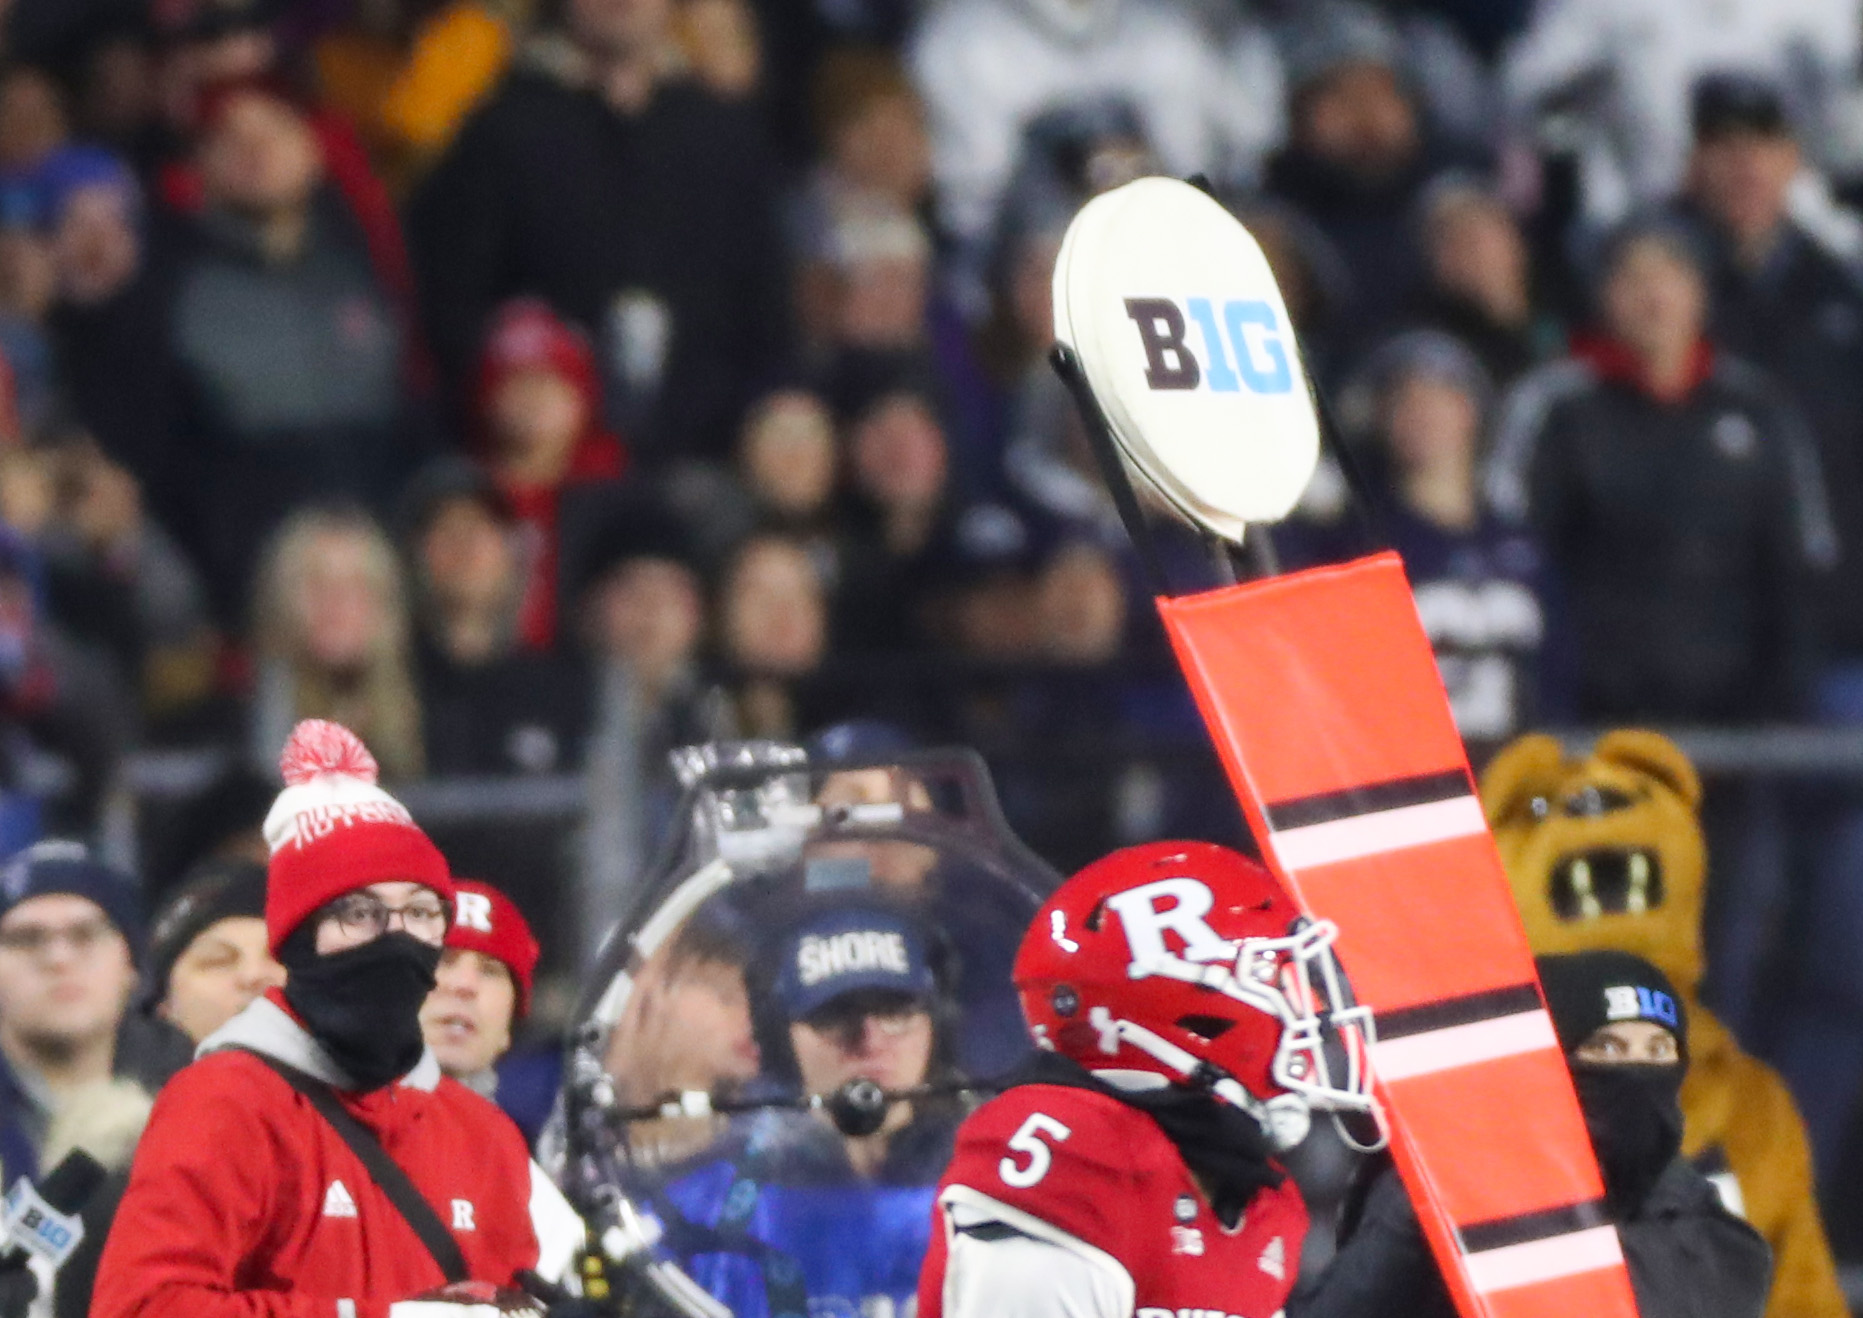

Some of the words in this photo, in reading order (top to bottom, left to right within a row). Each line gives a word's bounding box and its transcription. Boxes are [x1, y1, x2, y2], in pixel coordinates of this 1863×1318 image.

[454, 890, 493, 934] R
[1106, 876, 1238, 980] R
[796, 929, 910, 988] SHORE
[1000, 1111, 1073, 1189] 5
[451, 1198, 477, 1232] R
